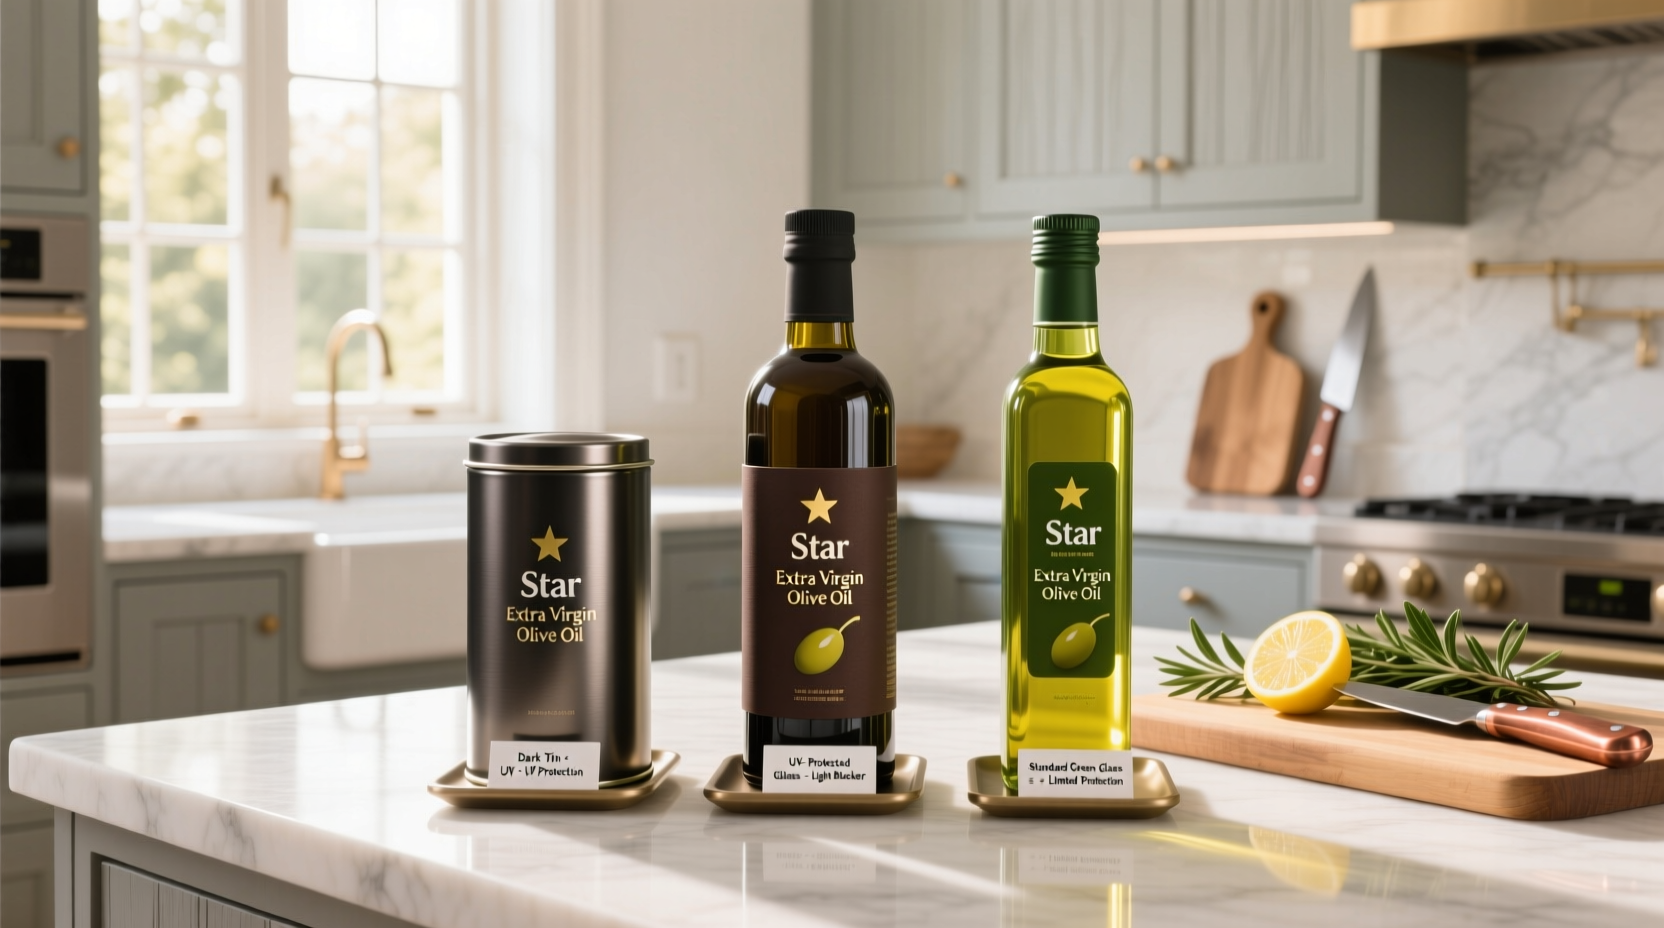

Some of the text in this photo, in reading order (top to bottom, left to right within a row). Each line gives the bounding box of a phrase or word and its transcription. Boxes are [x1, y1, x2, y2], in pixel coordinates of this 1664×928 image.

[1046, 519, 1102, 546] Star
[791, 532, 850, 561] Star
[776, 569, 864, 590] Extra Virgin
[1034, 568, 1069, 582] Extra
[520, 570, 582, 598] Star
[787, 589, 853, 605] Olive Oil
[1042, 586, 1101, 600] Olive Oil
[506, 605, 597, 626] Extra Virgin
[516, 626, 584, 643] Olive Oil
[518, 752, 541, 762] Dark
[500, 765, 515, 777] UV
